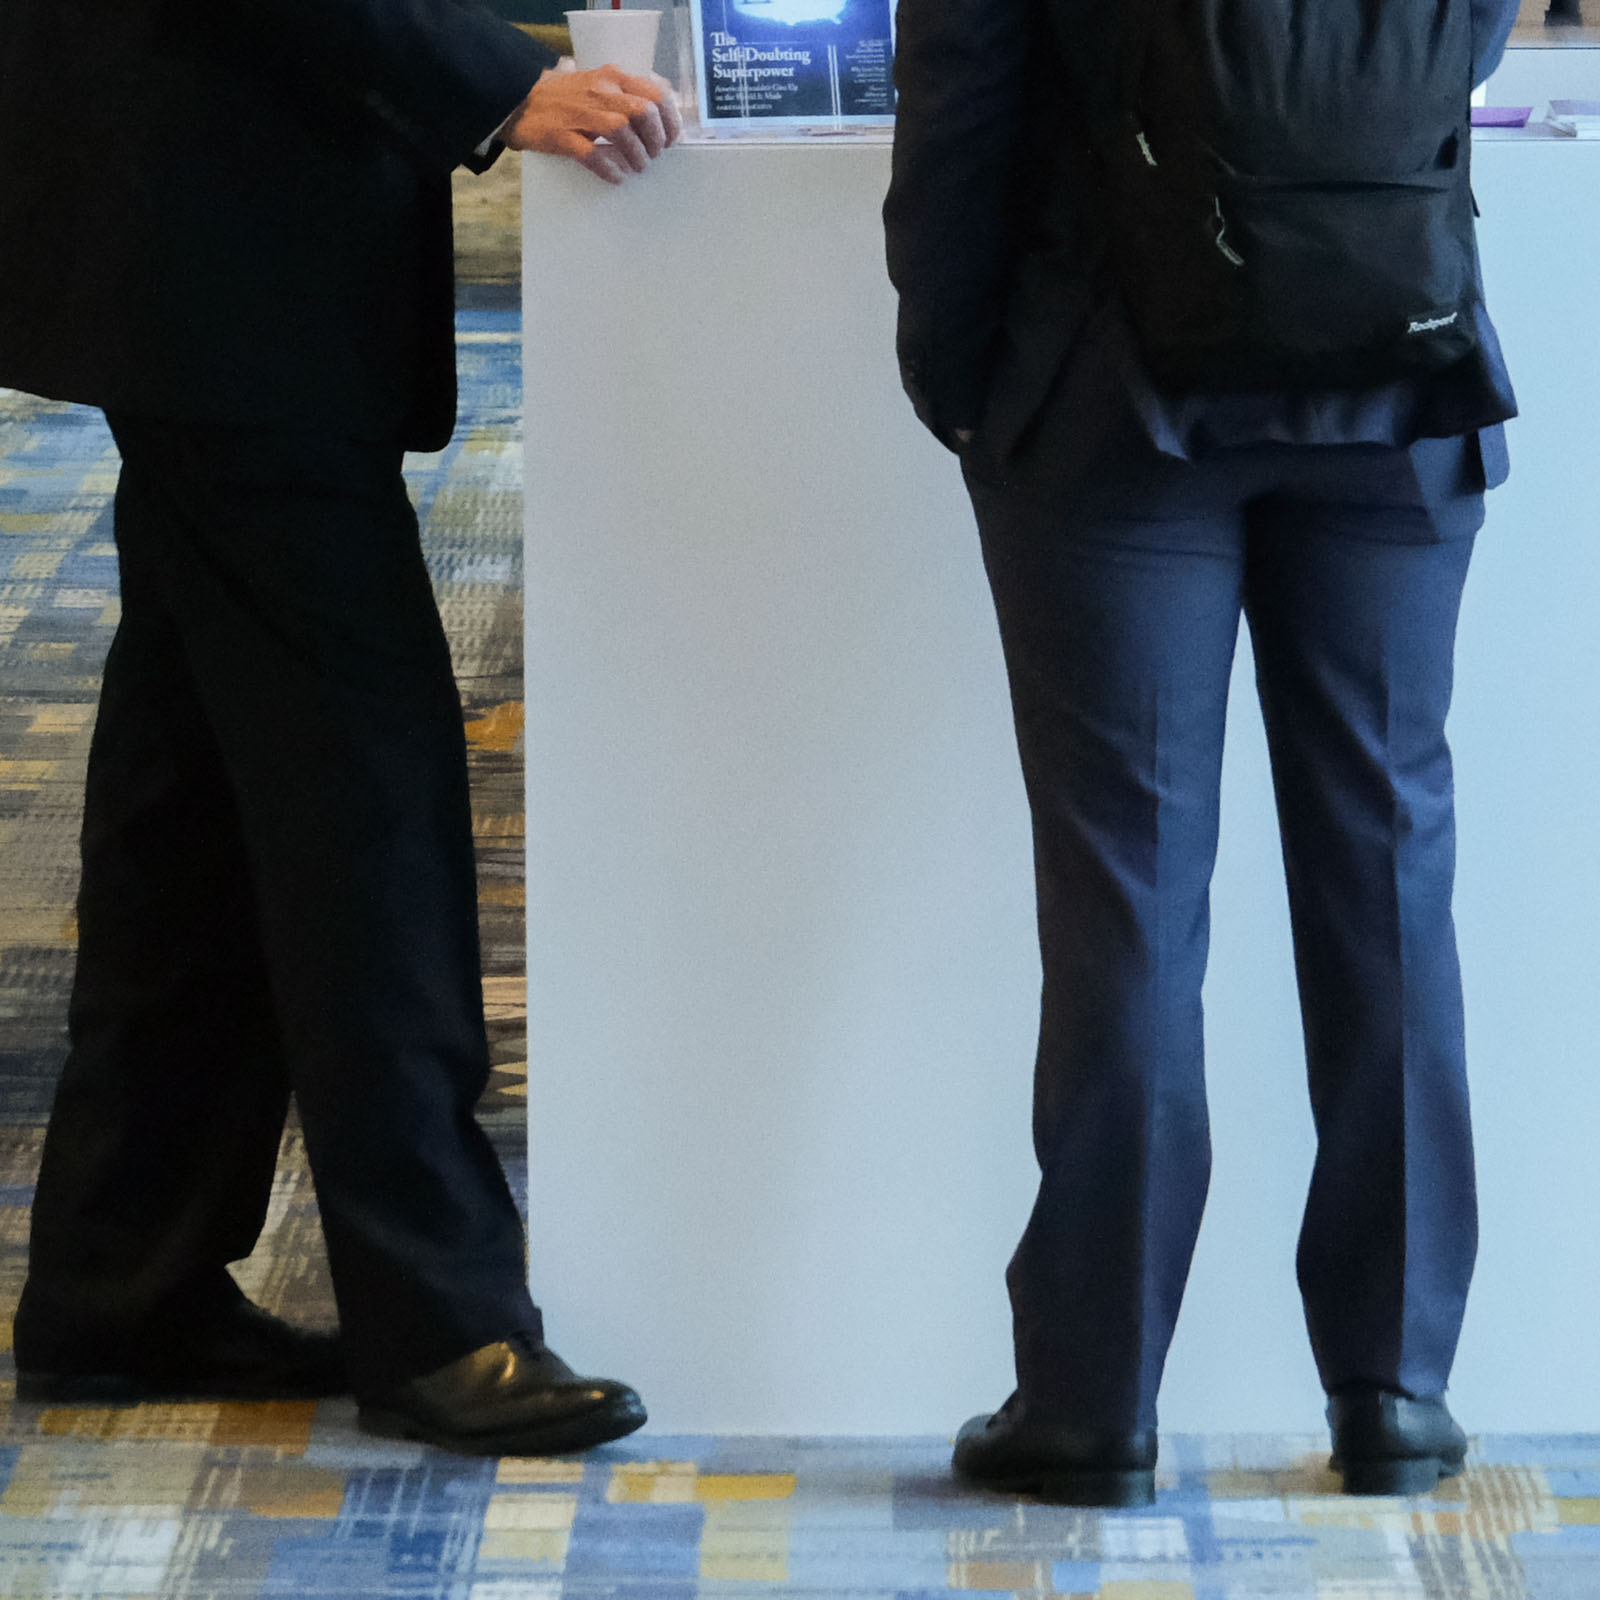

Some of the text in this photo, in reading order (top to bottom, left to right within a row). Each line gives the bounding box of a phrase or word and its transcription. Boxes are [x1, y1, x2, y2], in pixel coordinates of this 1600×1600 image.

[710, 31, 737, 46] The
[712, 47, 811, 65] Self-Doubting
[713, 63, 794, 82] Superpower
